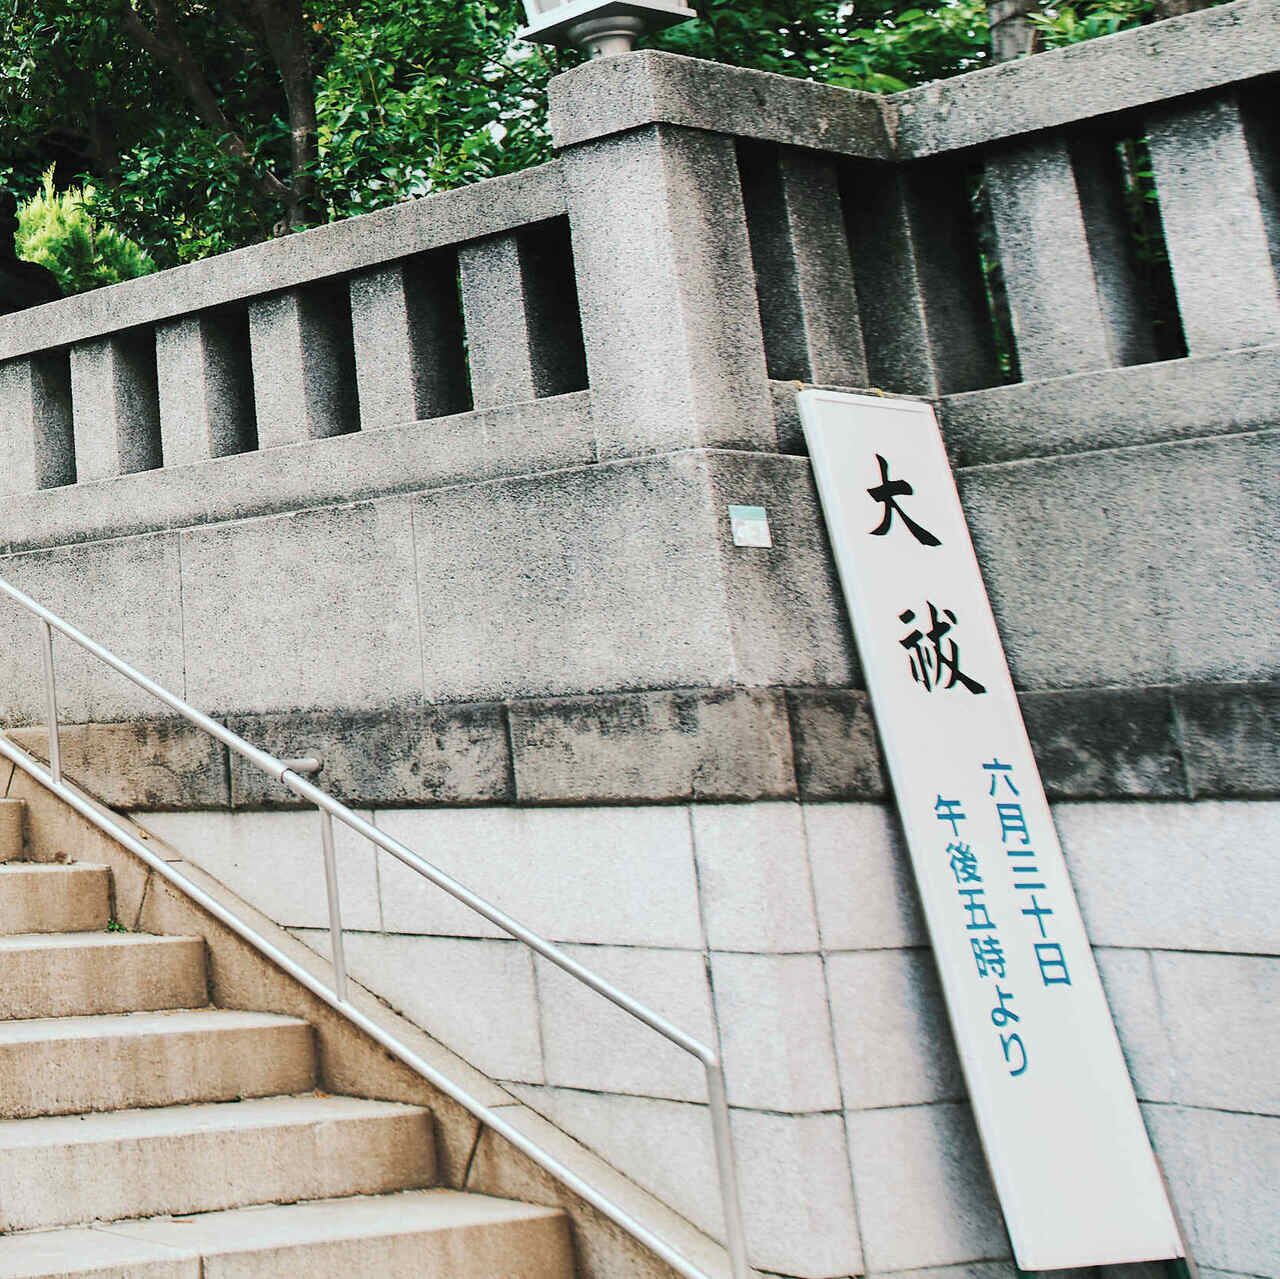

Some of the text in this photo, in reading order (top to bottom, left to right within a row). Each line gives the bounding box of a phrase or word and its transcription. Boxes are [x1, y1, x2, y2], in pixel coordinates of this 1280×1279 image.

[866, 453, 986, 696] 大祓
[934, 793, 1029, 1078] 午後五時より
[981, 756, 1072, 987] 六月三十日
